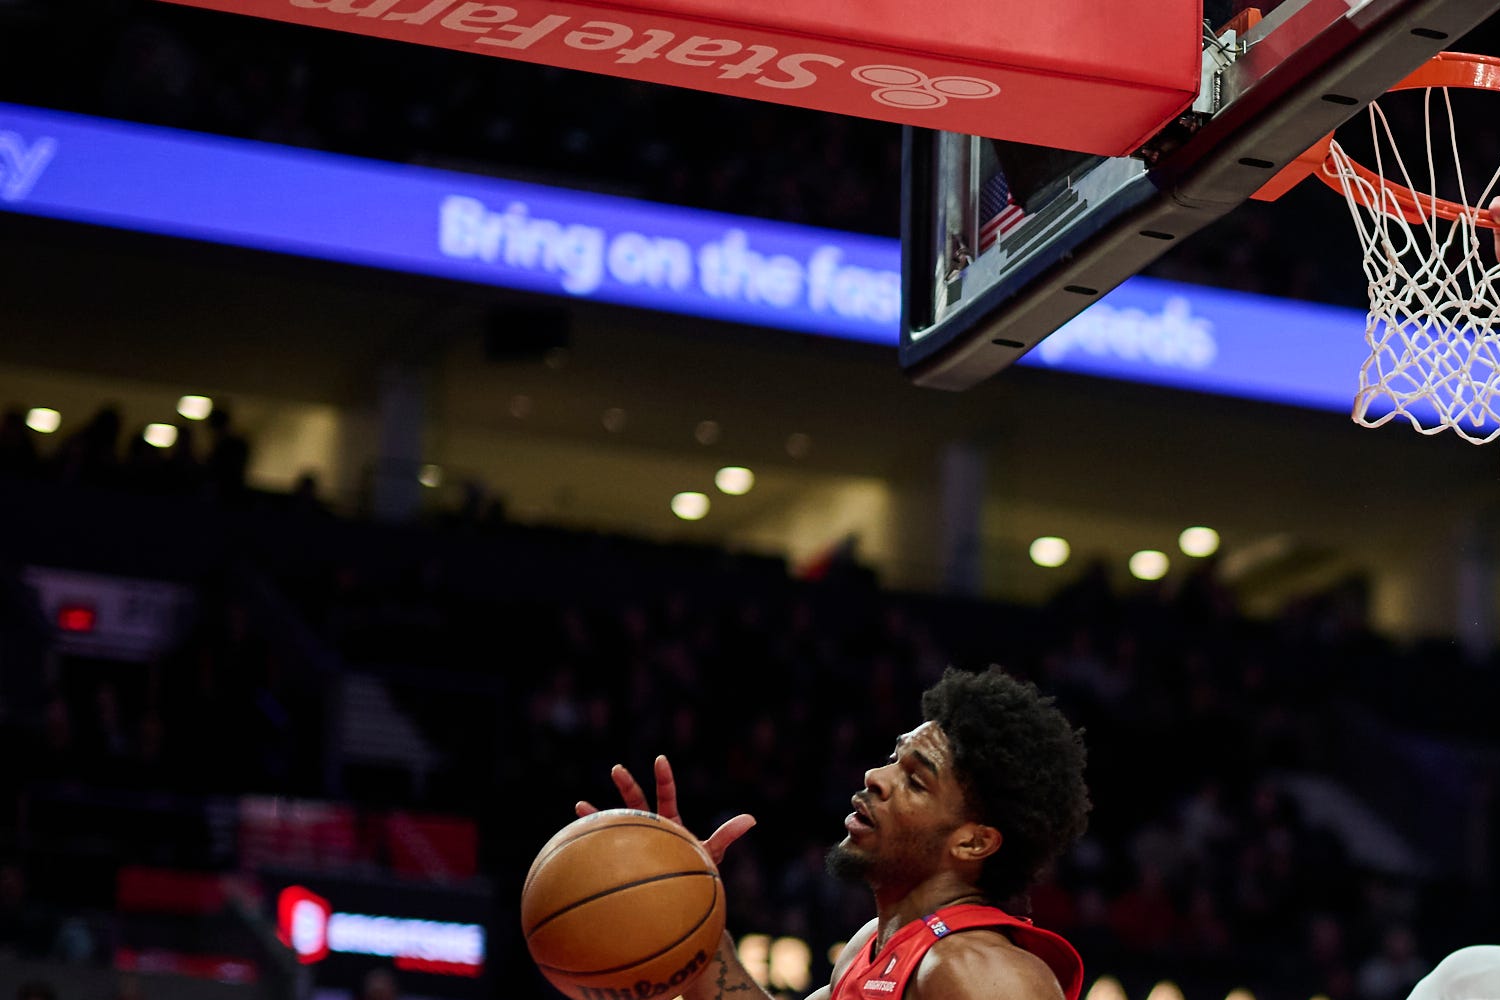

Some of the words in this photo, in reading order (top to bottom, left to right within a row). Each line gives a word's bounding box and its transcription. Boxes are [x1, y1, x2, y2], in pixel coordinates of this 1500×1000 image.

[438, 196, 604, 295] Bring
[608, 232, 692, 291] on
[700, 229, 801, 308] the
[808, 246, 901, 322] fas
[1040, 296, 1218, 371] peeds
